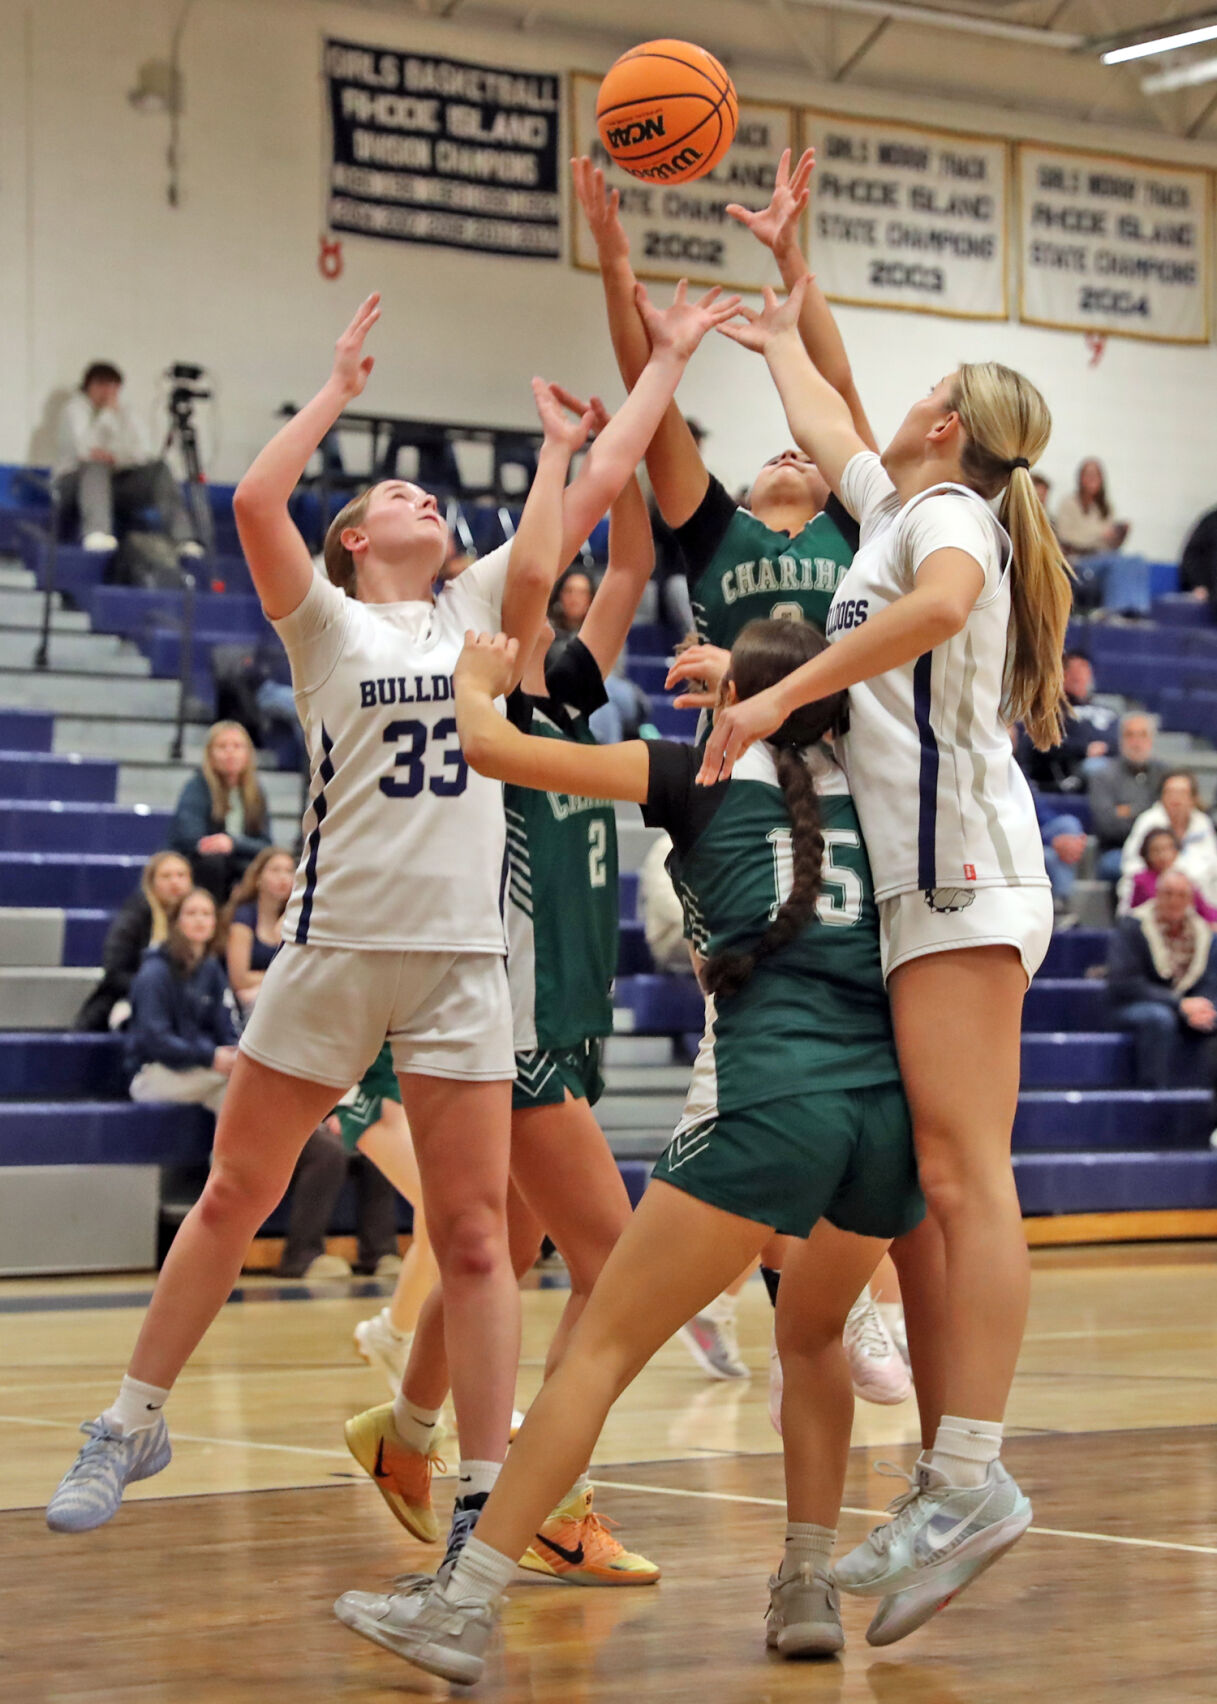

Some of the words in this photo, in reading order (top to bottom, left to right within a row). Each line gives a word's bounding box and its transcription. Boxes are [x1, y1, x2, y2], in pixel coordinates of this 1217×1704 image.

[606, 115, 665, 149] NCAA
[908, 185, 994, 222] ISLAND
[644, 229, 725, 266] 2002
[818, 211, 876, 247] STATE
[870, 257, 944, 294] 2003
[1079, 284, 1150, 318] 2004
[360, 674, 454, 708] BULLD
[379, 718, 468, 798] 33
[588, 818, 607, 889] 2
[765, 827, 863, 926] 15
